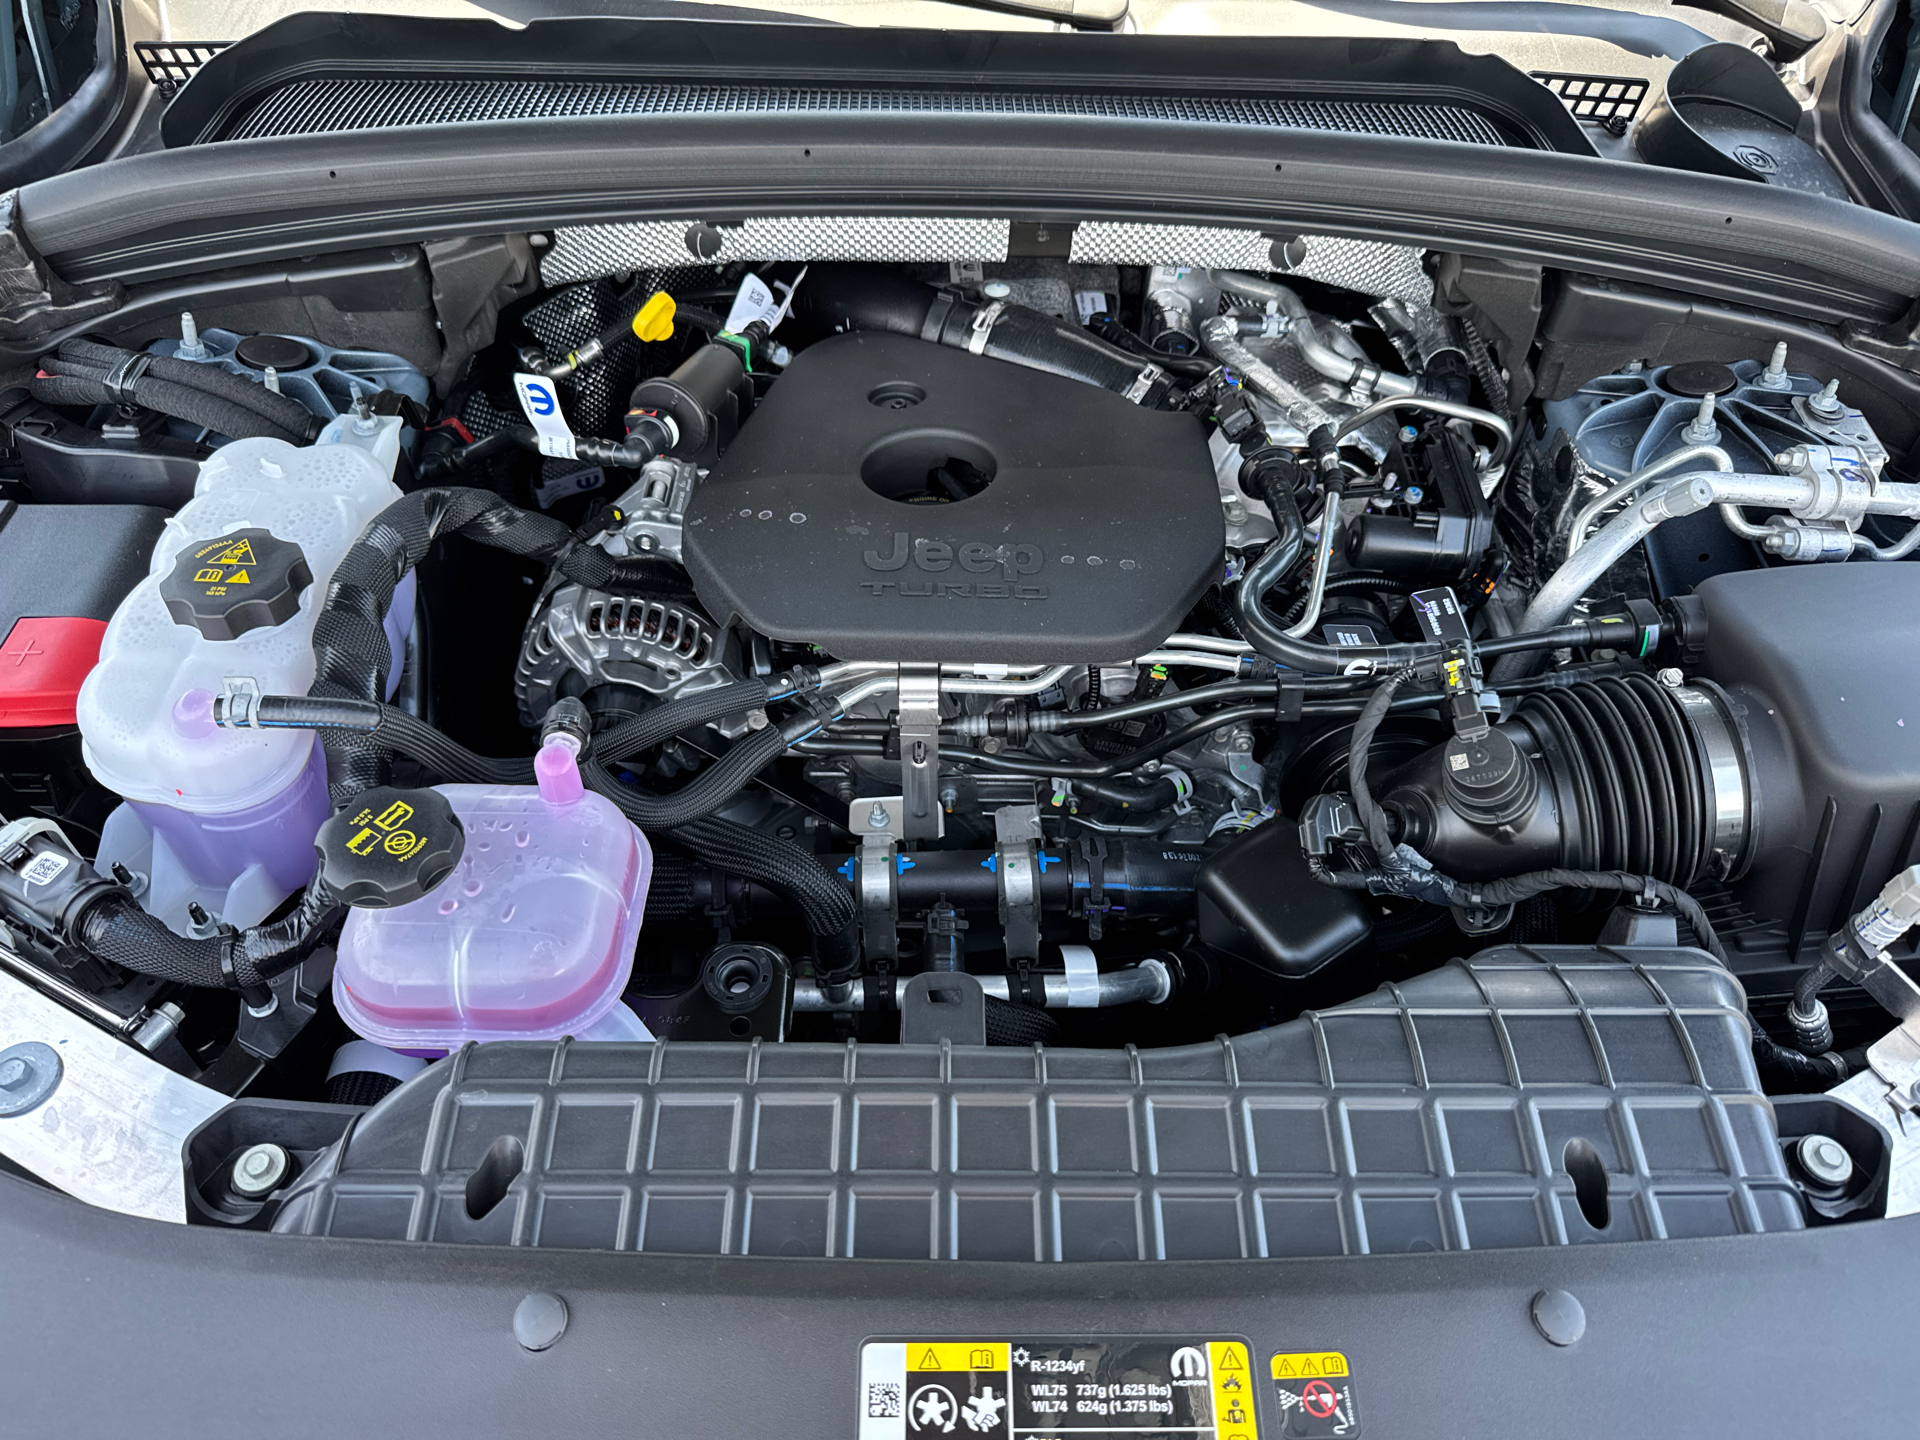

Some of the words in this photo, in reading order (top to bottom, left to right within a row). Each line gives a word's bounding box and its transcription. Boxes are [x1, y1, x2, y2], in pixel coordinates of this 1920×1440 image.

[864, 532, 1045, 582] Jeep
[860, 581, 1049, 600] TURBO
[1030, 1360, 1085, 1374] R-1234yf
[1031, 1384, 1068, 1396] WL75
[1076, 1384, 1107, 1398] 737g
[1109, 1384, 1147, 1398] (1.625
[1148, 1384, 1173, 1398] lbs)
[1032, 1400, 1068, 1413] WL74
[1076, 1400, 1108, 1415] 624g
[1109, 1400, 1148, 1415] (1.375
[1149, 1400, 1173, 1415] lbs)
